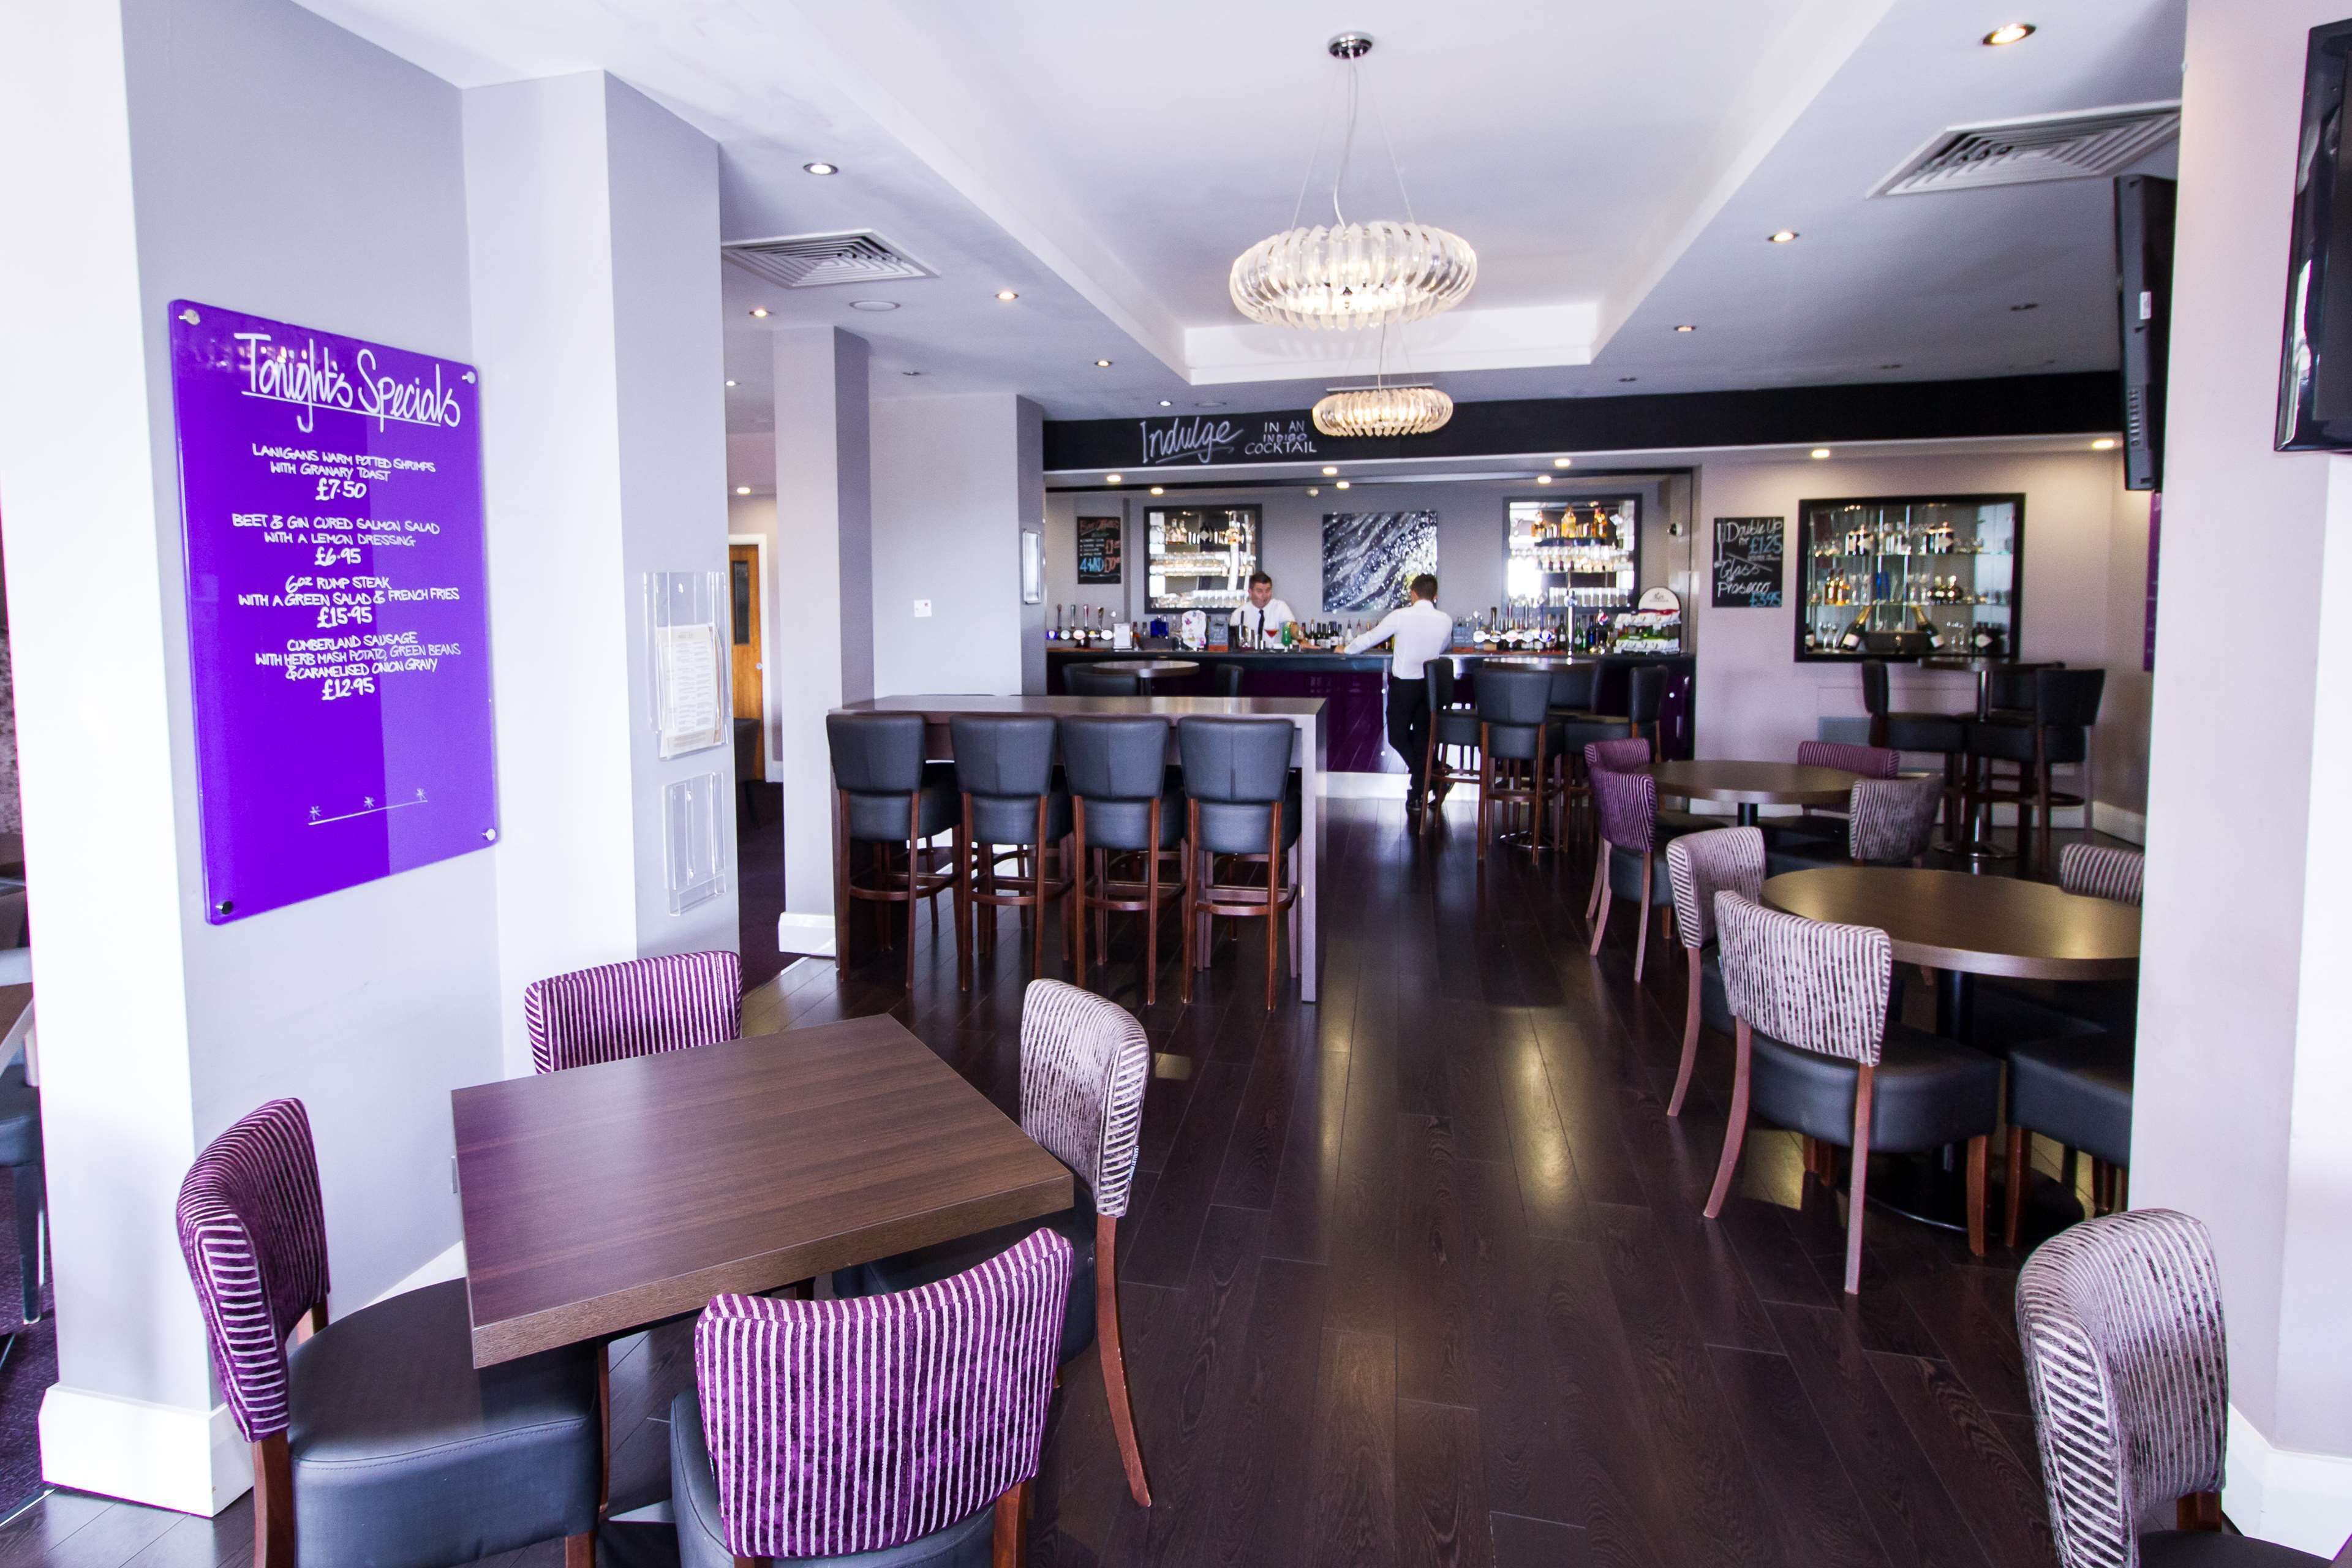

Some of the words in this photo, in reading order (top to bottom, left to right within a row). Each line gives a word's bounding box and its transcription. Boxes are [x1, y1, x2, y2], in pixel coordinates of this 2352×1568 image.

[234, 333, 353, 432] Tonight's
[357, 349, 460, 432] Specials
[1264, 421, 1279, 433] IN
[1289, 420, 1305, 432] AN
[1140, 417, 1244, 464] Indulge
[1244, 441, 1317, 455] COCKTAIL
[1262, 433, 1308, 443] INDIGO
[252, 443, 319, 461] LANIGANS
[322, 451, 353, 465] WARM
[355, 454, 392, 469] POTTED
[393, 458, 436, 472] SHRIMPS
[270, 461, 296, 475] WITH
[300, 463, 354, 480] GRANARY
[356, 467, 391, 481] TOAST
[232, 513, 268, 527] BEET
[270, 515, 284, 529] &
[287, 516, 309, 529] GIN
[313, 517, 353, 530] CURED
[356, 518, 401, 532] SALMON
[404, 521, 440, 534] SALAD
[264, 532, 293, 543] WITH
[298, 533, 308, 543] A
[311, 533, 353, 545] LEMON
[358, 533, 417, 547] DRESSING
[316, 576, 350, 590] RUMP
[352, 576, 392, 590] STEAK
[1717, 582, 1771, 598] Prosecco
[238, 594, 269, 606] WITH
[273, 594, 284, 607] A
[284, 593, 331, 606] GREEN
[332, 592, 371, 605] SALAD
[372, 590, 386, 605] &
[388, 589, 429, 602] FRENCH
[430, 587, 460, 600] FRIES
[287, 635, 362, 652] CUMBERLAND
[363, 631, 418, 646] SAUSAGE
[255, 652, 282, 666] WITH
[284, 652, 316, 668] HERB
[317, 650, 347, 665] MASH
[389, 645, 427, 657] GREEN
[428, 643, 461, 656] BEANS
[371, 660, 404, 674] ONION
[404, 658, 439, 673] GRAVY
